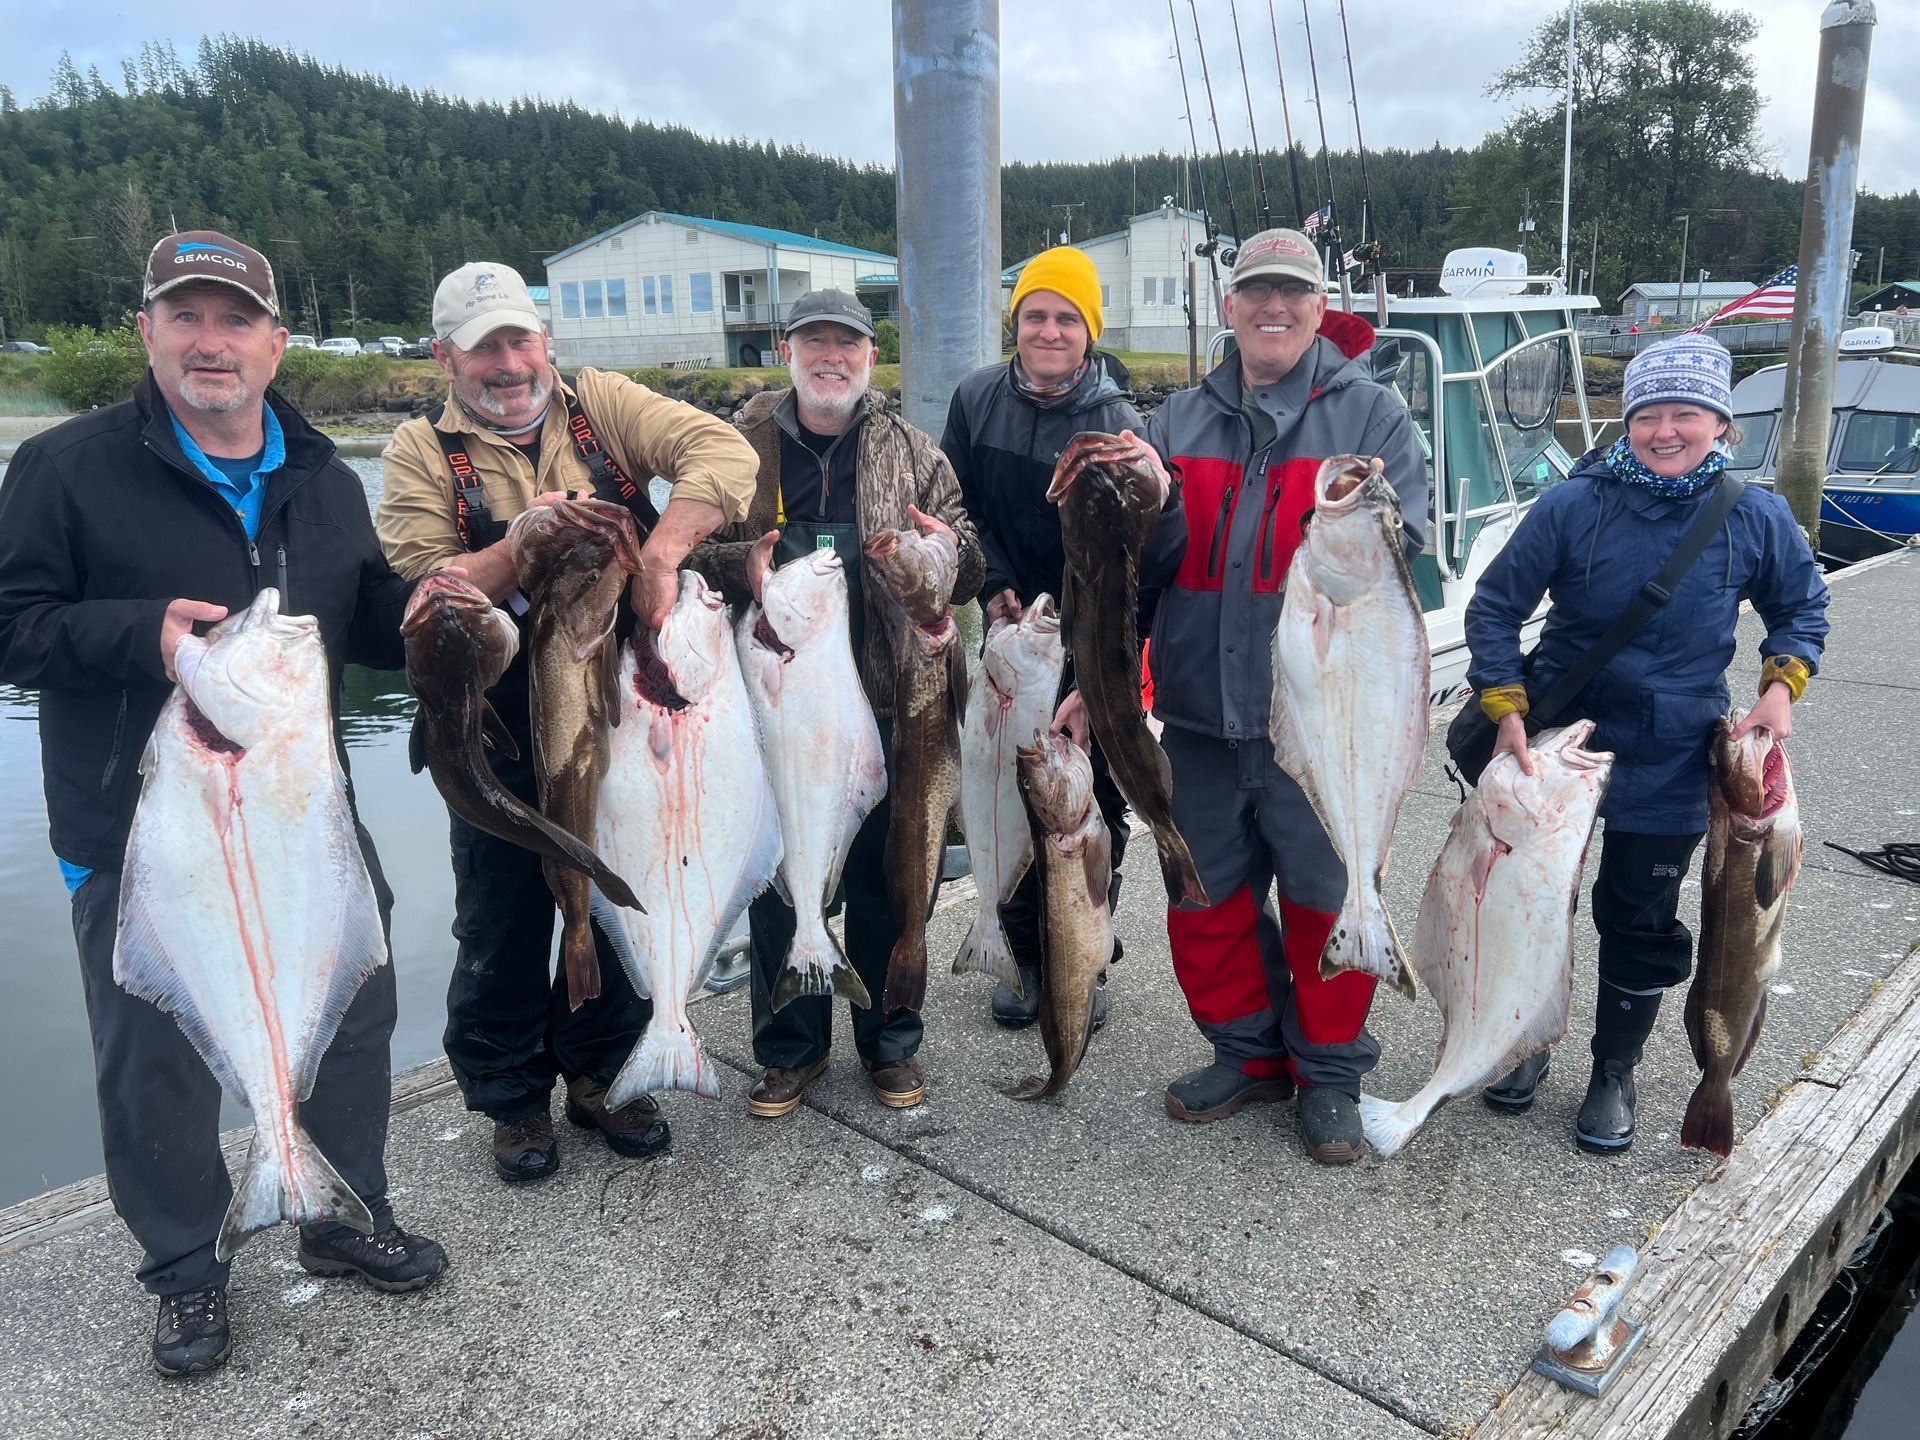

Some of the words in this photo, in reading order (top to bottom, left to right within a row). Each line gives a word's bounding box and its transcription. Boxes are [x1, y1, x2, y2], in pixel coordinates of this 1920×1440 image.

[174, 253, 248, 272] GEMCOR
[1443, 267, 1495, 278] GARMIN
[1844, 339, 1881, 347] GARMIN
